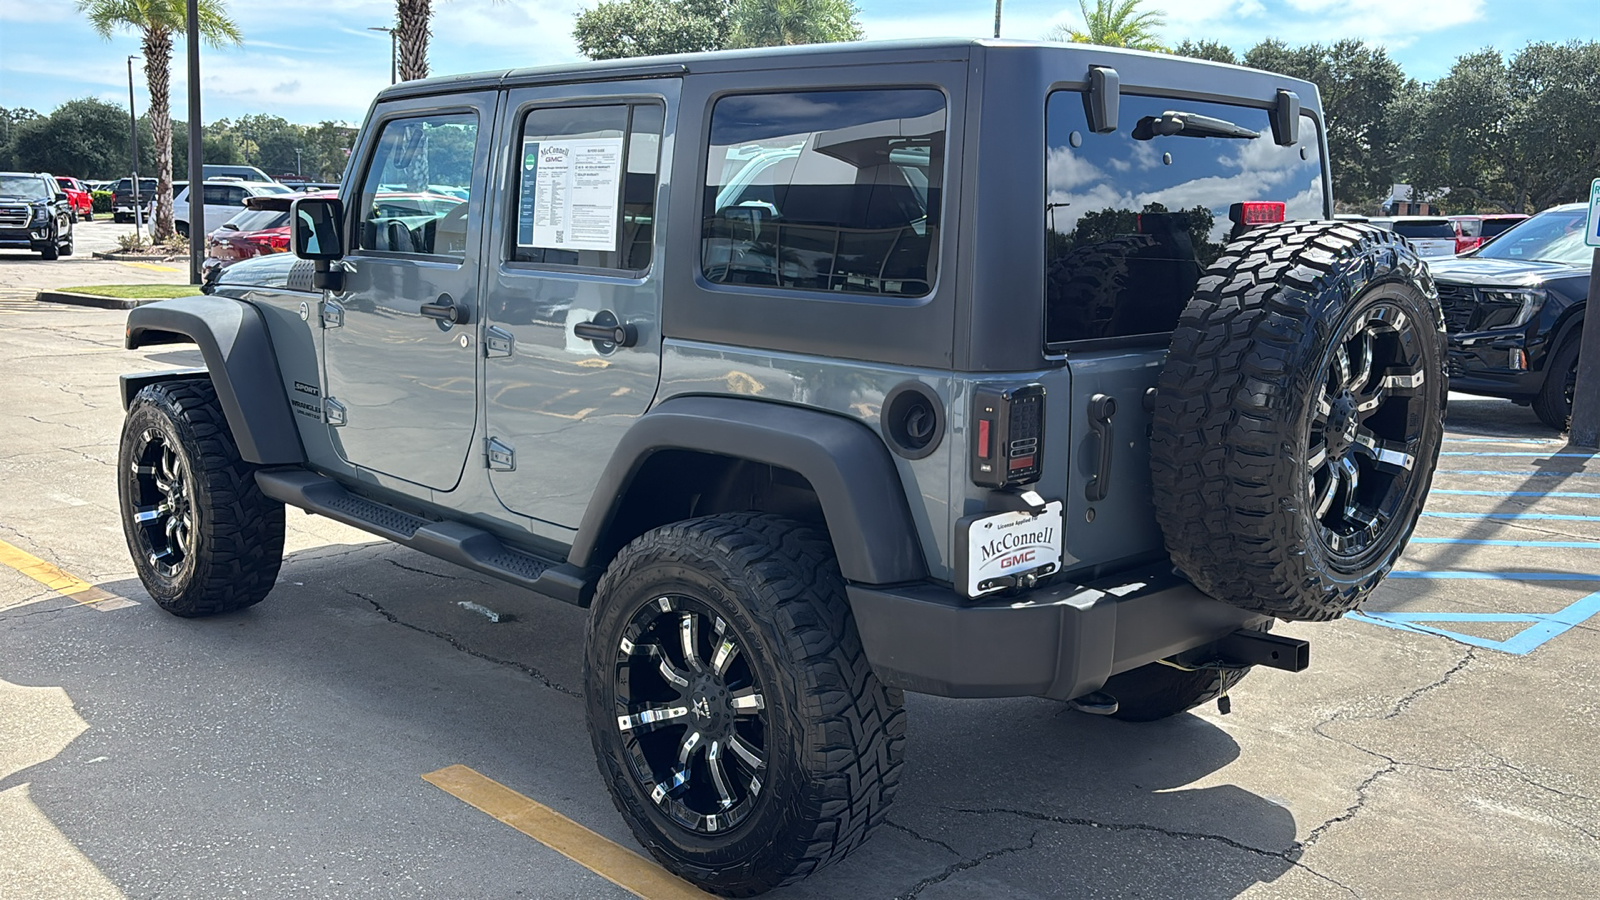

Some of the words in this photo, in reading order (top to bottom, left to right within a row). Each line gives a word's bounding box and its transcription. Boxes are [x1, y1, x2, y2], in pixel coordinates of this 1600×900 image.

[541, 146, 569, 157] McConnell
[295, 383, 318, 394] SPORT
[997, 521, 1014, 530] License
[1015, 517, 1031, 526] Applied
[981, 527, 1053, 562] McConnell
[1000, 550, 1035, 569] GMC
